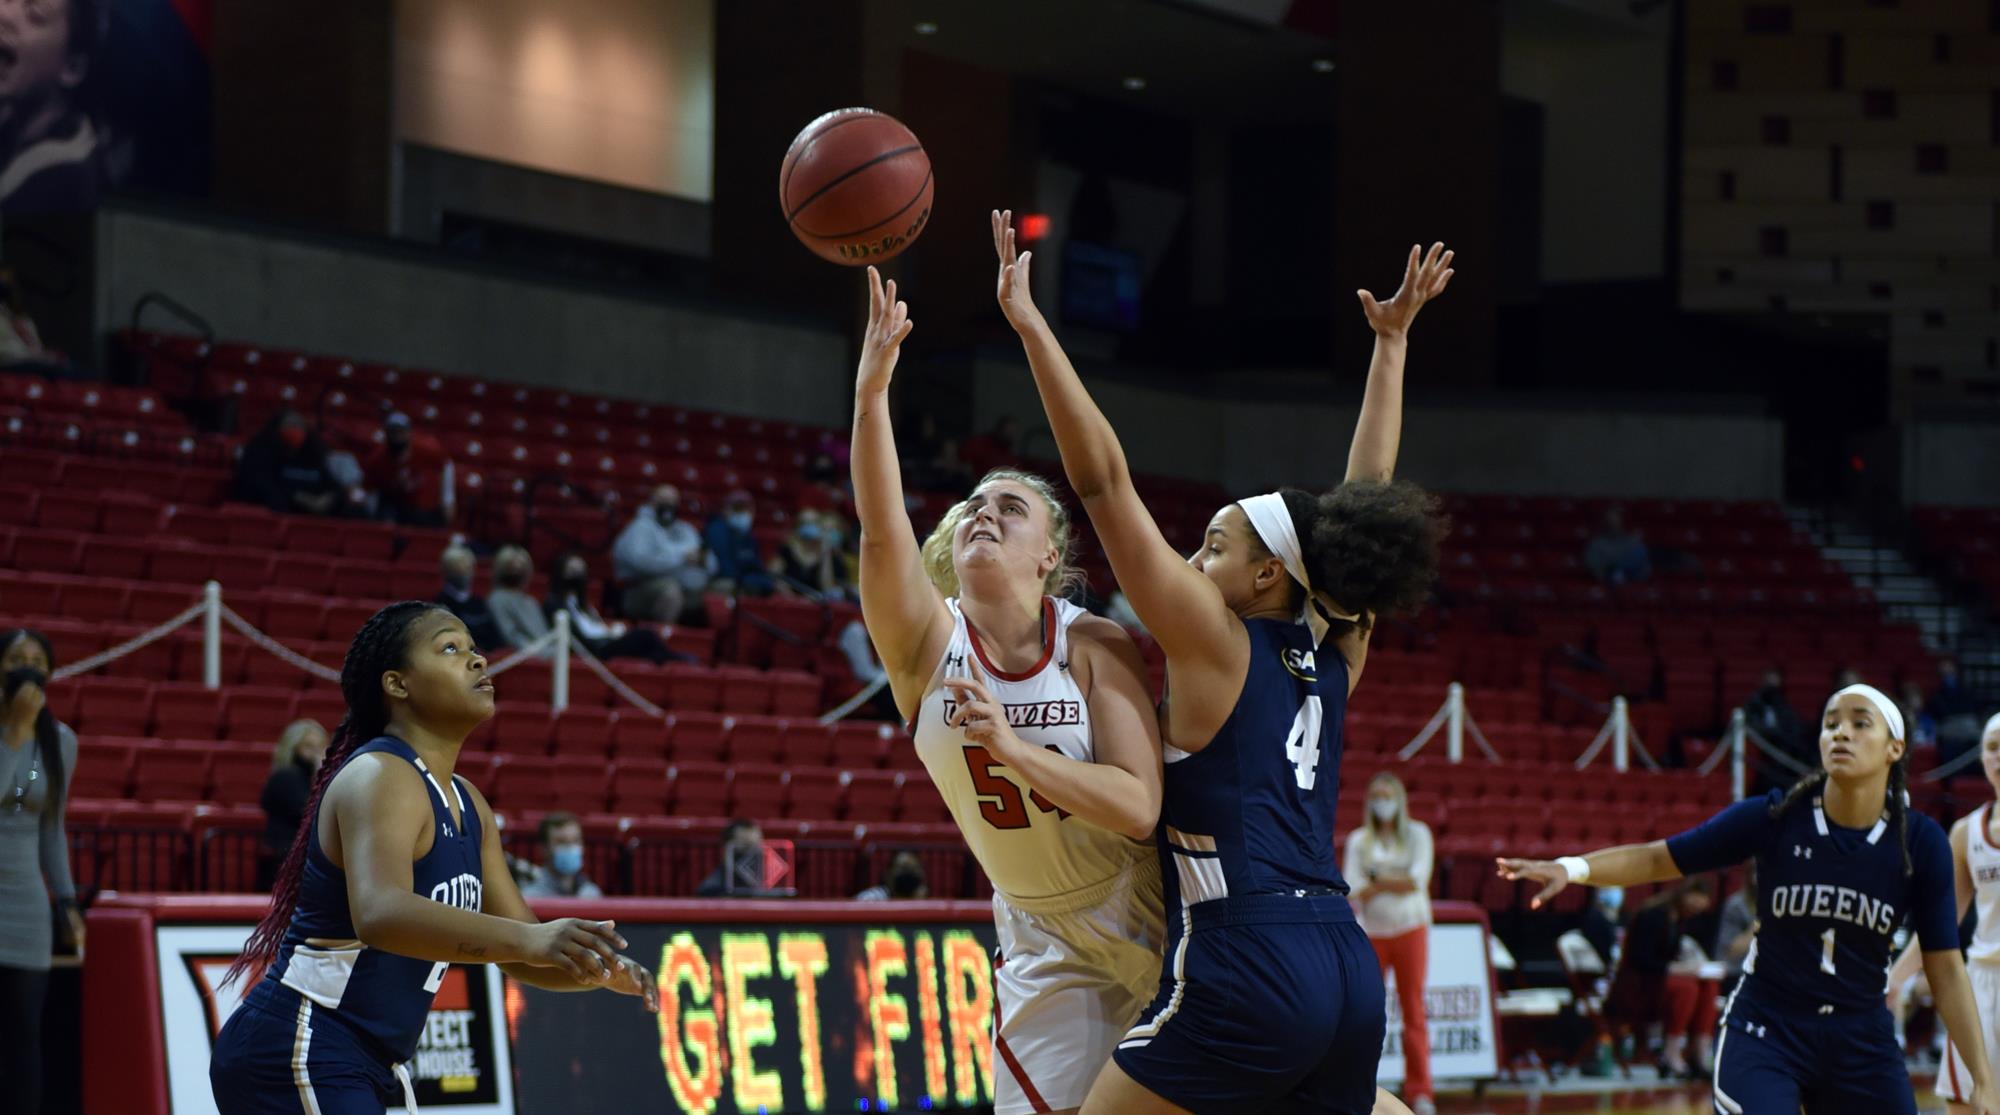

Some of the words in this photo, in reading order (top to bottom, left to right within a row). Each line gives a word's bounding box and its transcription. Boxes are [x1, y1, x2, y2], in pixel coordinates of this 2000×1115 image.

[837, 207, 929, 258] Wilson
[1285, 695, 1323, 790] 4
[1772, 884, 1895, 935] QUEENS
[1820, 927, 1836, 976] 1
[657, 930, 829, 1115] GET
